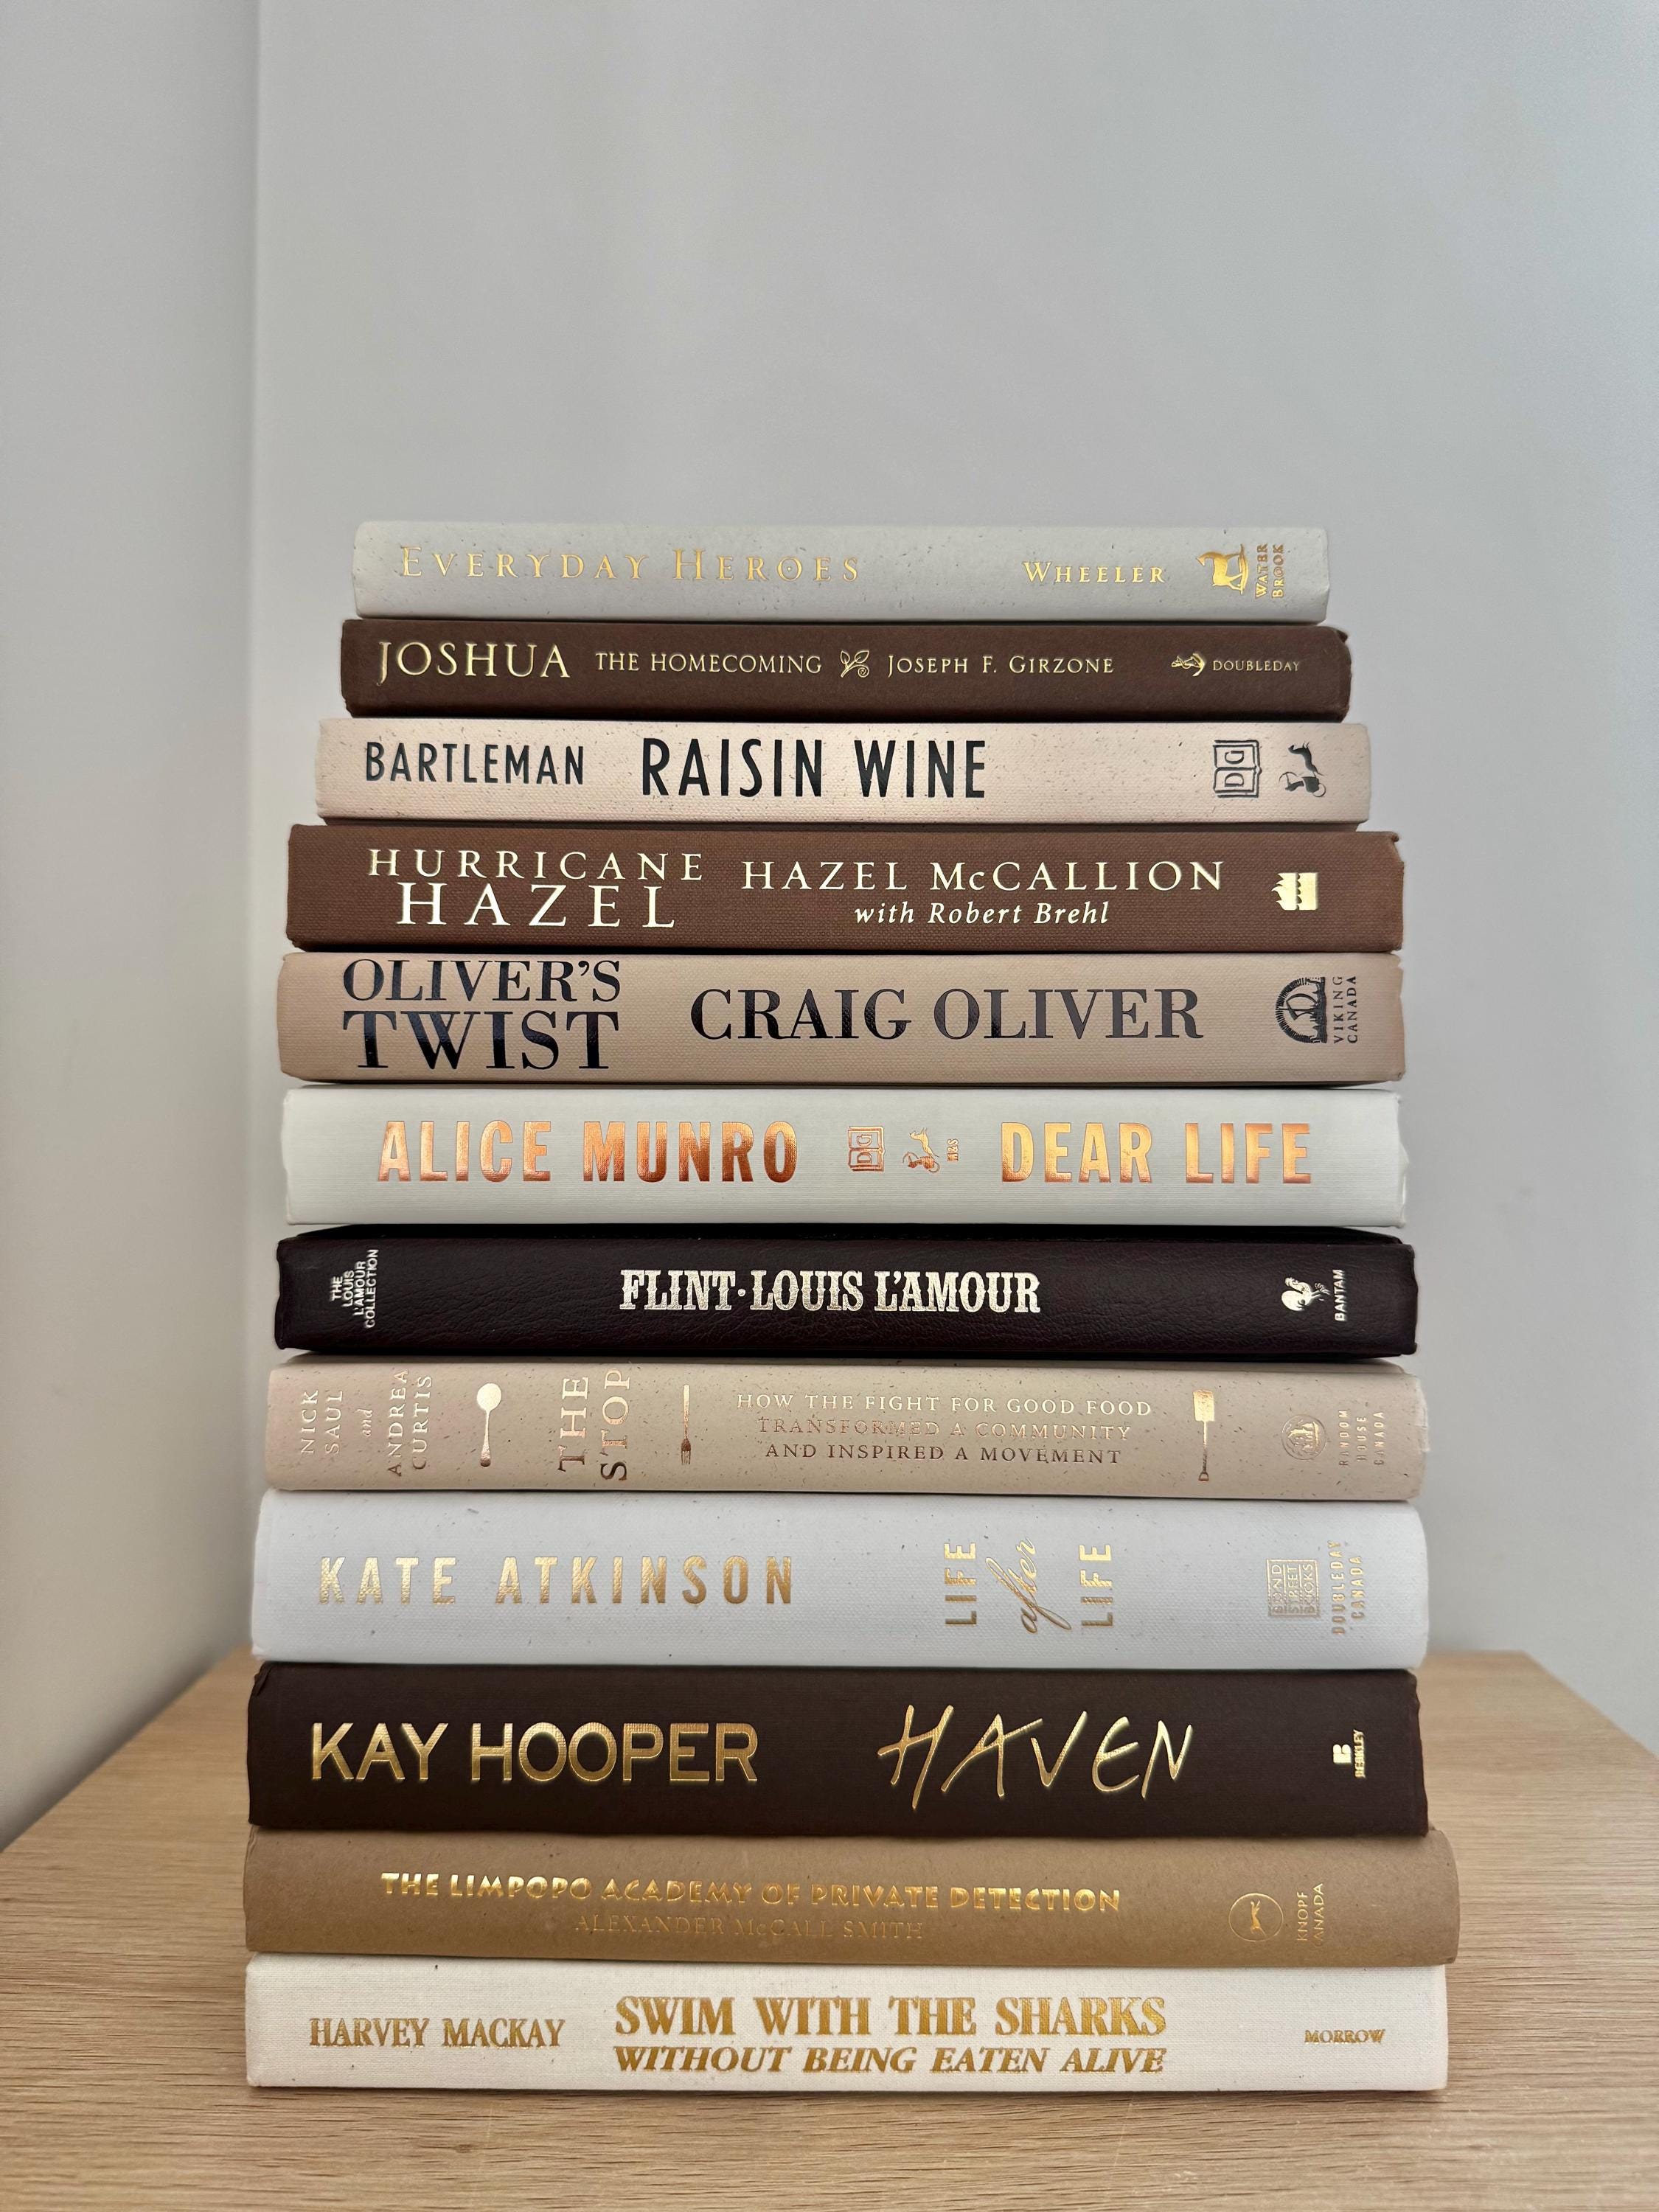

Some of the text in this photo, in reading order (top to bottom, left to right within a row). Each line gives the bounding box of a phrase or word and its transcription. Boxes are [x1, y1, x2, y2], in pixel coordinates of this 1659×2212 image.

[400, 546, 859, 582] EVERYDAY HEROES
[1023, 560, 1166, 584] WHEELER
[1255, 543, 1268, 599] WATER
[1272, 543, 1284, 599] BROOK
[378, 641, 822, 686] JOSHUA THE HOMECOMING
[887, 655, 1115, 678] JOSEPH F. GIRZONE
[1213, 660, 1301, 672] DOUBLEDAY
[366, 741, 584, 785] BARTLEMAN
[642, 738, 986, 799] RAISIN WINE
[369, 848, 703, 882] HURRICANE
[740, 860, 1225, 892] HAZEL McCALLION
[396, 882, 675, 929] HAZEL
[854, 901, 1109, 925] with Robert Brehl
[343, 959, 621, 1002] OLIVER'S
[689, 988, 1203, 1040] CRAIG OLIVER
[1332, 976, 1344, 1044] VIKING
[1346, 976, 1358, 1044] CANADA
[343, 1009, 619, 1070] TWIST
[377, 1119, 798, 1183] ALICE MUNRO
[1001, 1121, 1312, 1184] DEAR LIFE
[330, 1276, 343, 1301] THE
[341, 1270, 355, 1307] LOUIS
[352, 1261, 366, 1316] L'AMOUR
[364, 1249, 379, 1329] COLLECTION
[874, 1270, 1041, 1313] L'AMOUR
[1332, 1269, 1346, 1322] BANTAM
[301, 1390, 318, 1455] NICK
[325, 1391, 343, 1455] SAUL
[356, 1408, 373, 1438] and
[388, 1369, 408, 1477] ANDREA
[413, 1376, 432, 1470] CURTIS
[557, 1377, 589, 1472] THE
[600, 1368, 630, 1481] STOP
[737, 1394, 1152, 1416] HOW THE FIGHT FOR GOOD FOOD
[758, 1418, 1133, 1440] TRANSFORMED A COMMUNITY
[765, 1443, 1121, 1464] AND INSPIRED A MOVEMENT
[1338, 1410, 1349, 1465] RANDOM
[1357, 1416, 1367, 1462] HOUSE
[1373, 1411, 1385, 1465] CANADA
[318, 1555, 792, 1605] KATE ATKINSON
[944, 1542, 977, 1625] LIFE
[985, 1537, 1072, 1633] after
[1079, 1545, 1113, 1626] LIFE
[1272, 1564, 1284, 1614] BOND
[1304, 1563, 1315, 1614] BOOKS
[1327, 1540, 1346, 1635] DOUBLEDAY
[1349, 1556, 1365, 1619] CANADA
[311, 1722, 759, 1783] KAY HOOPER
[877, 1704, 1194, 1809] HAVEN
[380, 1872, 1121, 1913] THE LIMPOPO ACADEMY OF PRIVATE DETECTION
[1297, 1891, 1309, 1941] KNOPF
[575, 1915, 923, 1939] ALEXANDER McCALL SMITH
[310, 2017, 566, 2050] HARVEY MACKAY
[614, 1996, 1166, 2038] SWIM WITH THE SHARKS
[1304, 2028, 1386, 2044] MORROW
[613, 2045, 1165, 2075] WITHOUT BEING EATEN ALIVE
